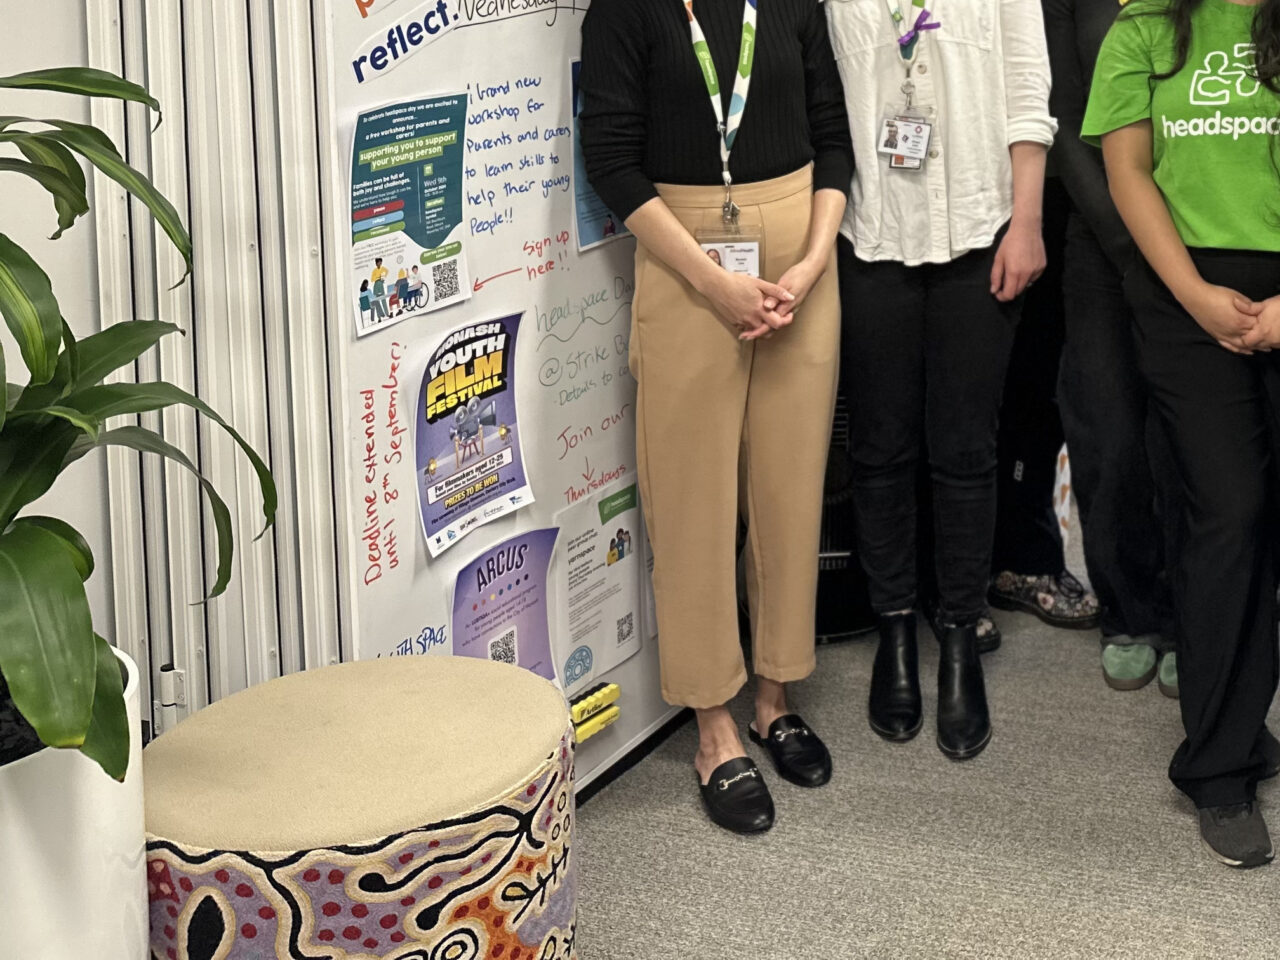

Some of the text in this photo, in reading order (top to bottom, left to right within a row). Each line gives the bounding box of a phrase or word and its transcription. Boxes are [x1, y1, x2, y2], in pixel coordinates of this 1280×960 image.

[352, 0, 459, 83] reflect.
[477, 76, 541, 100] brand new
[527, 98, 545, 113] for
[415, 120, 437, 129] parents
[438, 117, 450, 125] and
[517, 126, 539, 143] and
[360, 132, 457, 161] supporting you to support
[371, 146, 442, 170] your young person
[465, 153, 560, 179] to learn skills to
[467, 190, 495, 208] help
[504, 180, 536, 197] their
[541, 175, 570, 198] young
[556, 230, 570, 246] up
[429, 334, 506, 380] YOUTH
[539, 357, 563, 387] @
[566, 345, 610, 379] Strike
[427, 350, 503, 407] FILM
[601, 370, 613, 386] to
[427, 376, 502, 420] FESTIVAL
[557, 403, 630, 460] Join our
[360, 389, 382, 586] Deadline extended
[445, 474, 498, 509] PRIZES TO BE WON
[563, 464, 626, 504] Thursdays
[384, 518, 399, 569] until
[477, 543, 527, 592] ARCUS
